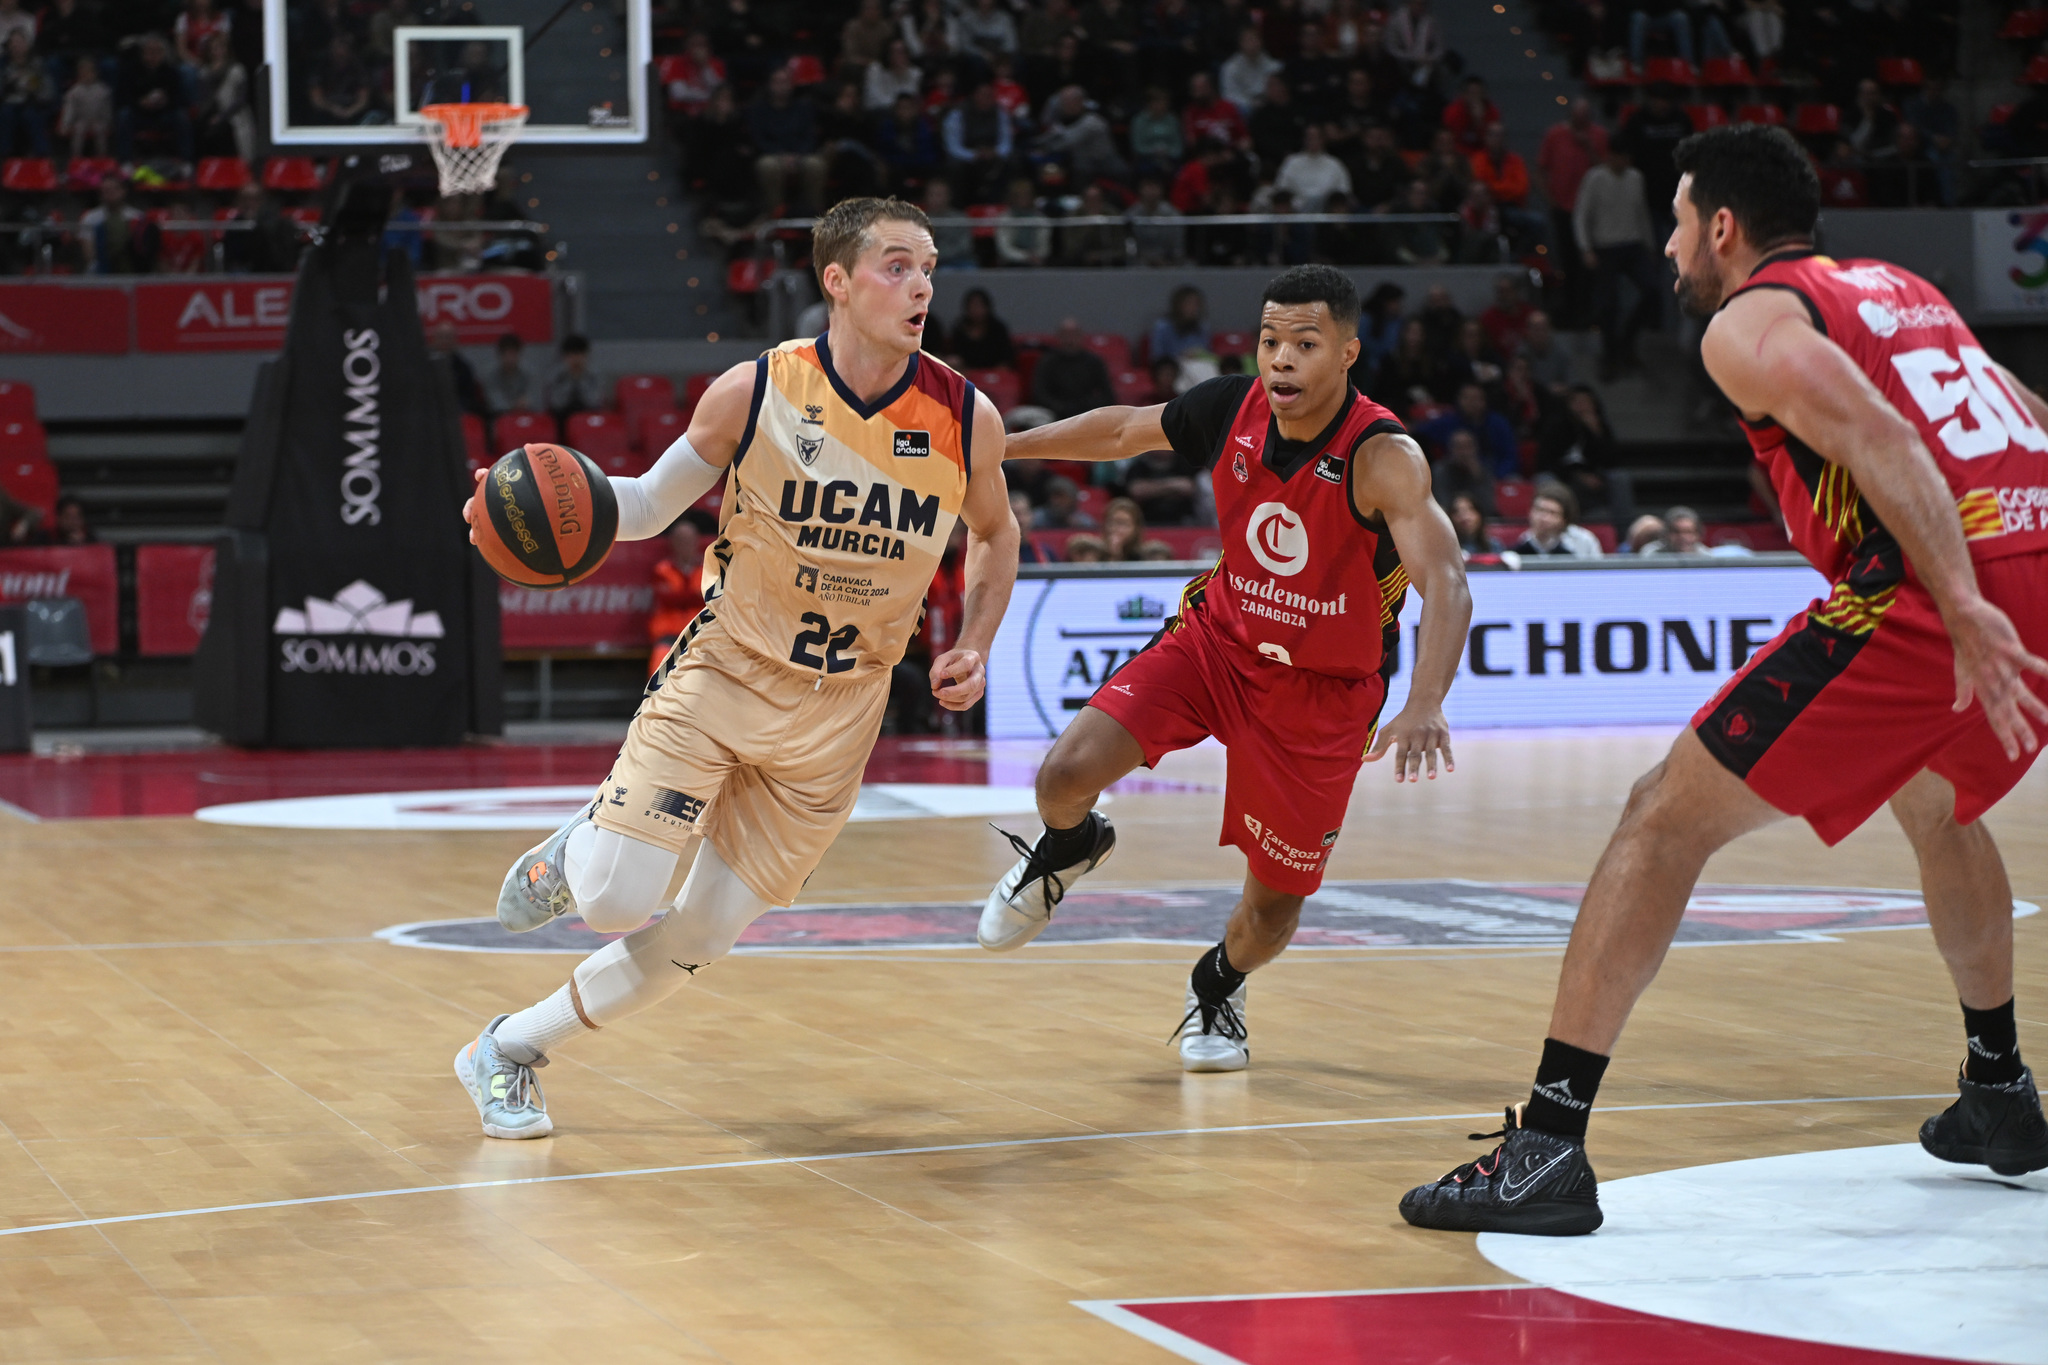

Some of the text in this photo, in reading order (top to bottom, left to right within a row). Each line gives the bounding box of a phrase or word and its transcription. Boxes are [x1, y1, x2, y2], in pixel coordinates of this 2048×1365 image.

[1890, 344, 2048, 461] 50
[341, 328, 381, 526] SOMMOS
[895, 438, 910, 449] liga
[895, 445, 928, 455] endesa
[1316, 465, 1341, 481] endesa
[535, 448, 581, 536] SPALDING
[778, 479, 940, 537] UCAM
[500, 485, 539, 553] endesa
[796, 525, 905, 561] MURCIA
[821, 583, 890, 597] DE LA CRUZ 2024
[822, 573, 873, 587] CARAVACA
[818, 592, 871, 607] AÑO JUBILAR
[1241, 599, 1307, 629] ZARAGOZA
[280, 638, 437, 677] SOMMOS
[789, 611, 861, 674] 22
[1261, 838, 1316, 872] DEPORTE
[1265, 828, 1320, 858] Zaragoza
[1533, 1083, 1590, 1111] MERCURY
